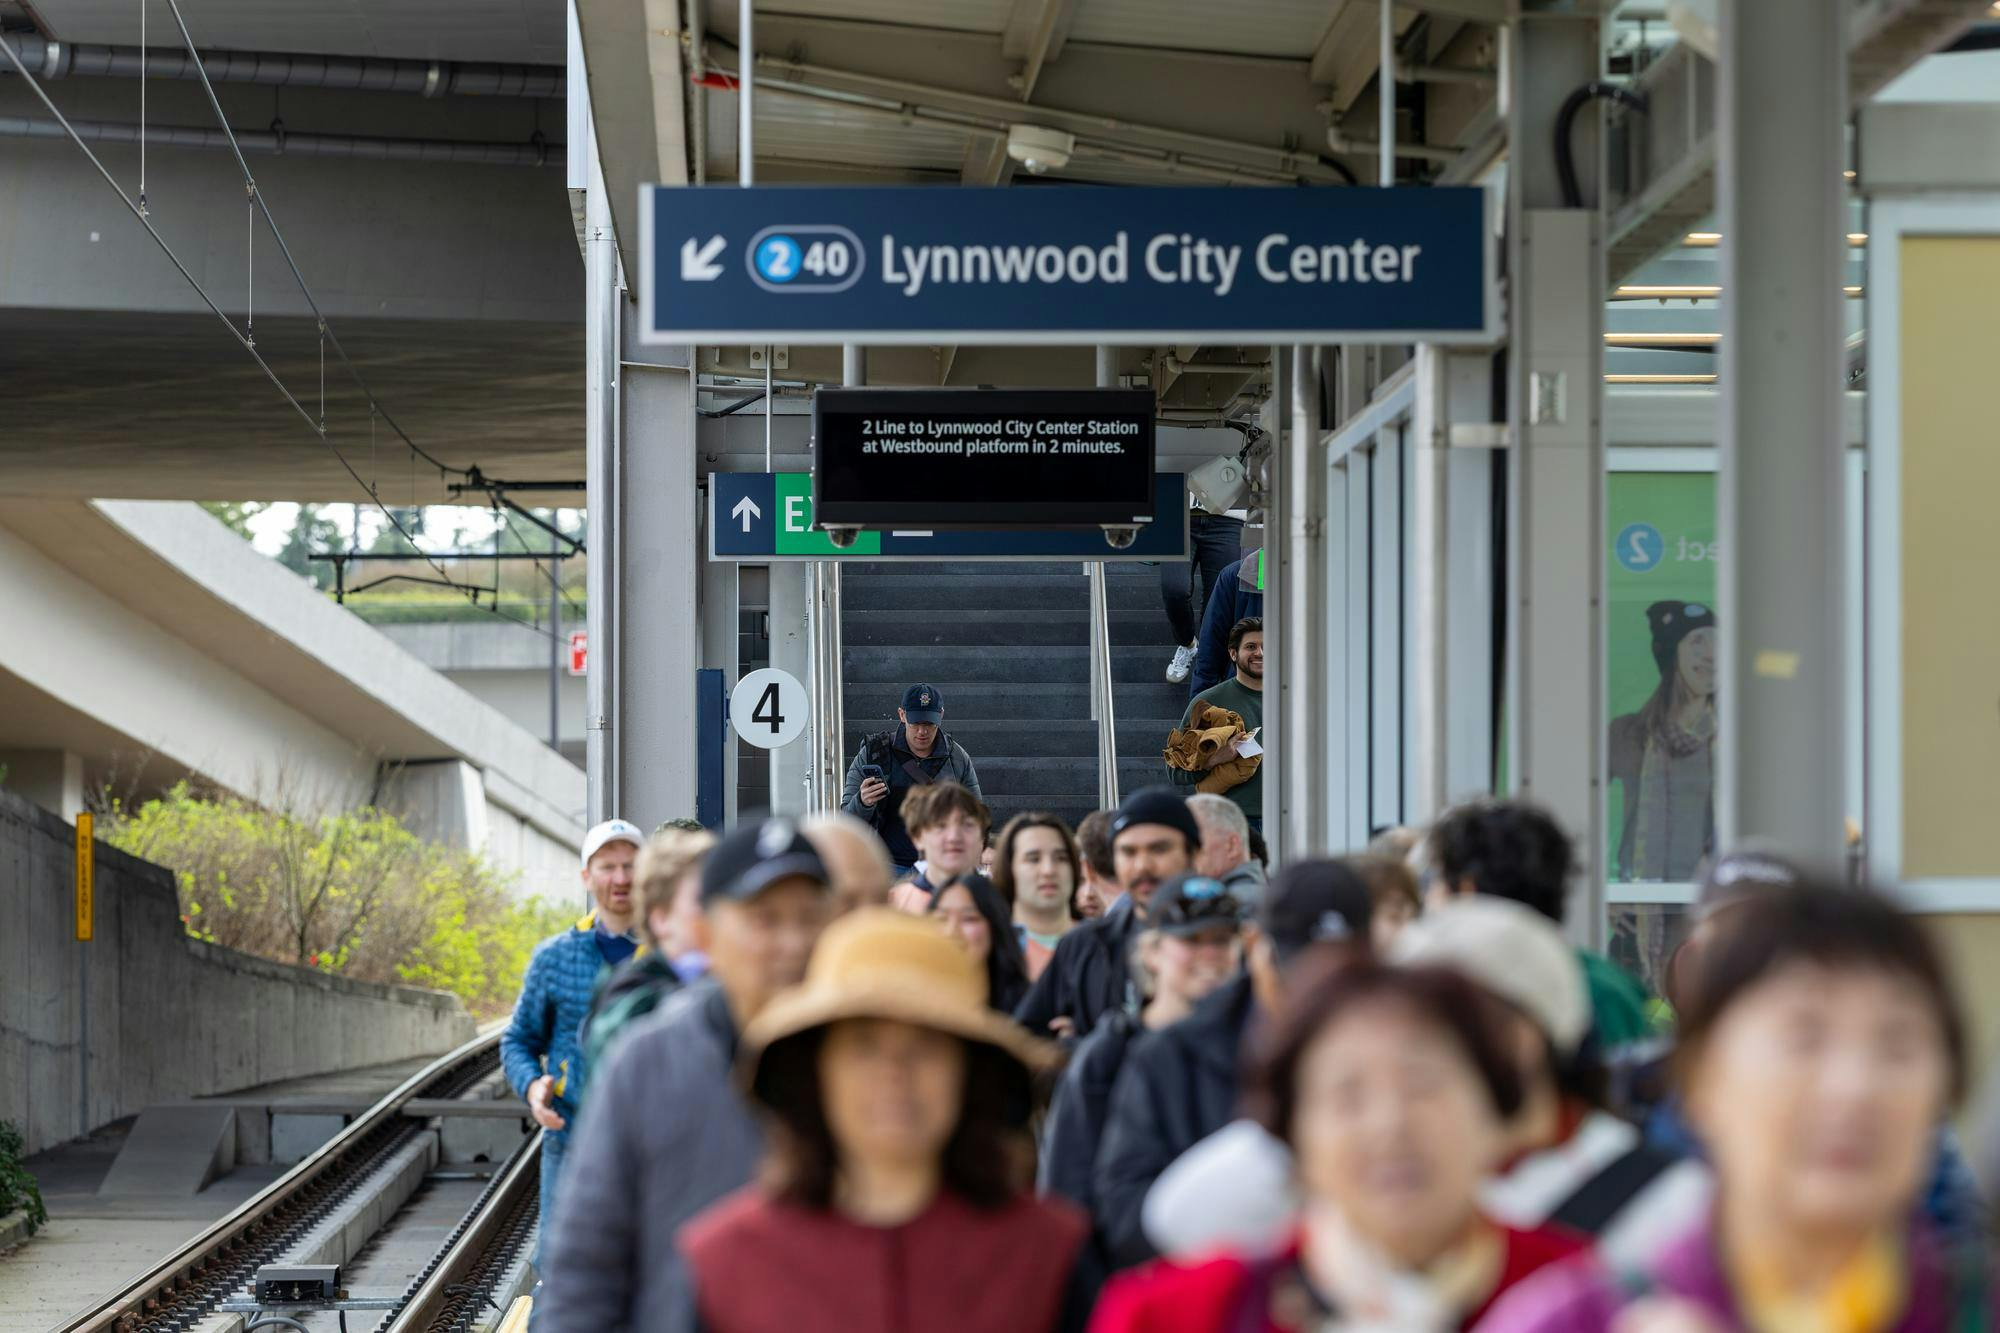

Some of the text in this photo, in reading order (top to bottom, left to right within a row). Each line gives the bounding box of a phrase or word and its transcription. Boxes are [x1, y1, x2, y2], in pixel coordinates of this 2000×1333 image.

[767, 232, 1421, 296] 2 40 Lynnwood City Center
[862, 420, 1139, 438] 2 Line to Lynnwood City Center Station
[862, 438, 1125, 457] at Westbound platform in 2 minutes.
[752, 683, 784, 733] 4
